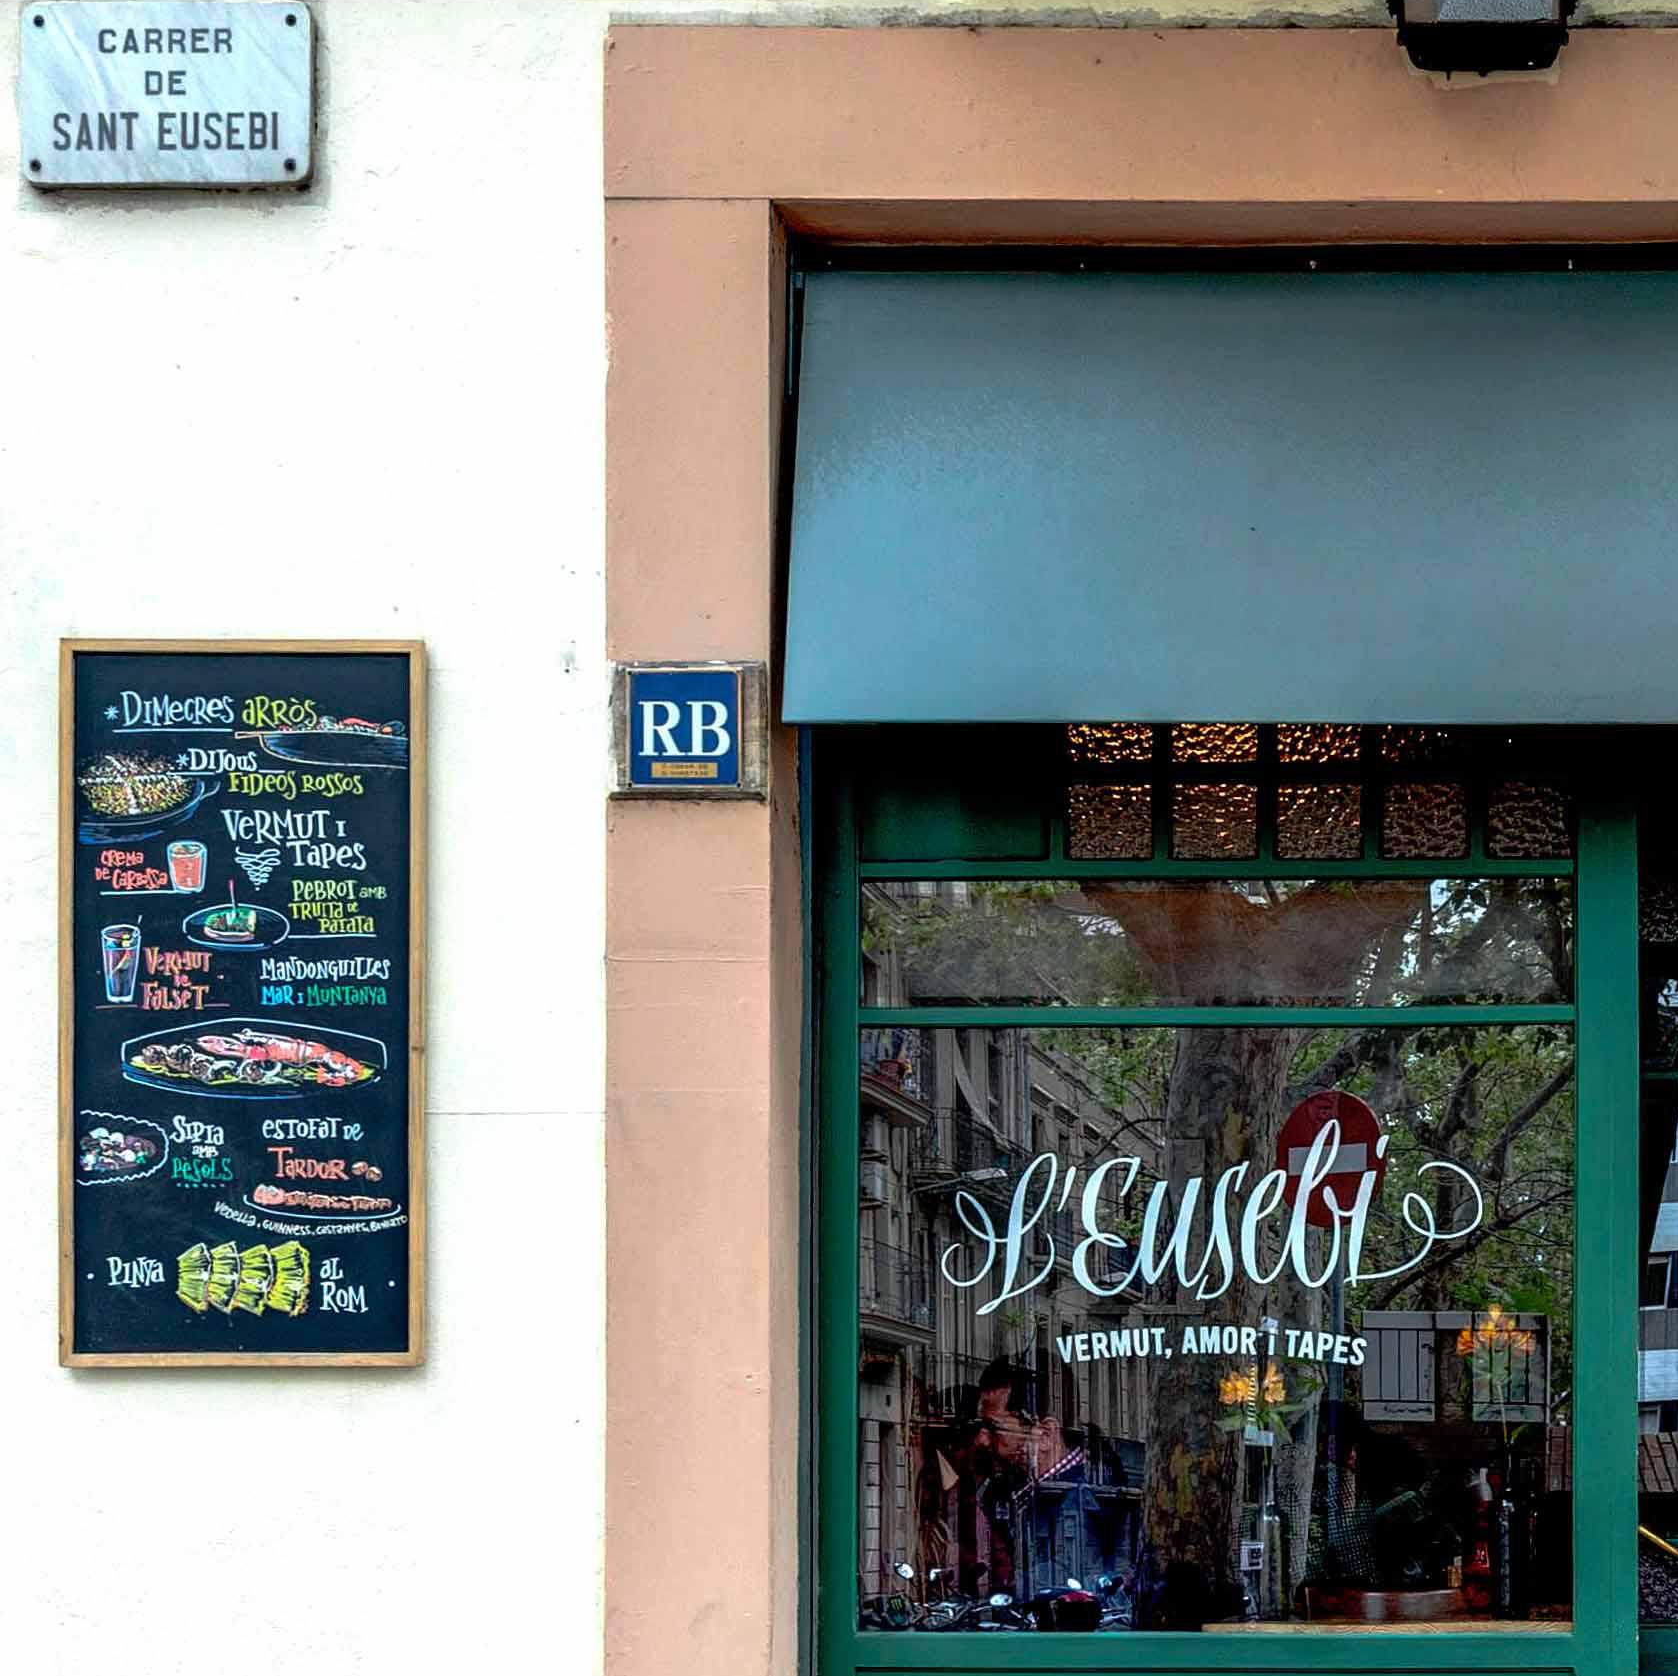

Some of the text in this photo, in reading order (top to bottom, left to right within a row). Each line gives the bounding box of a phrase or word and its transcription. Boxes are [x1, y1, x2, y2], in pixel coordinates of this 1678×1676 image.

[98, 28, 232, 54] CARRER
[144, 70, 187, 96] DE
[53, 112, 279, 151] SANT EUSEBI
[638, 700, 731, 756] RB
[941, 1119, 1484, 1316] L'Eusebi
[1056, 1328, 1172, 1365] VERMUT,
[1181, 1326, 1257, 1356] AMOR
[1285, 1328, 1368, 1366] TAPES
